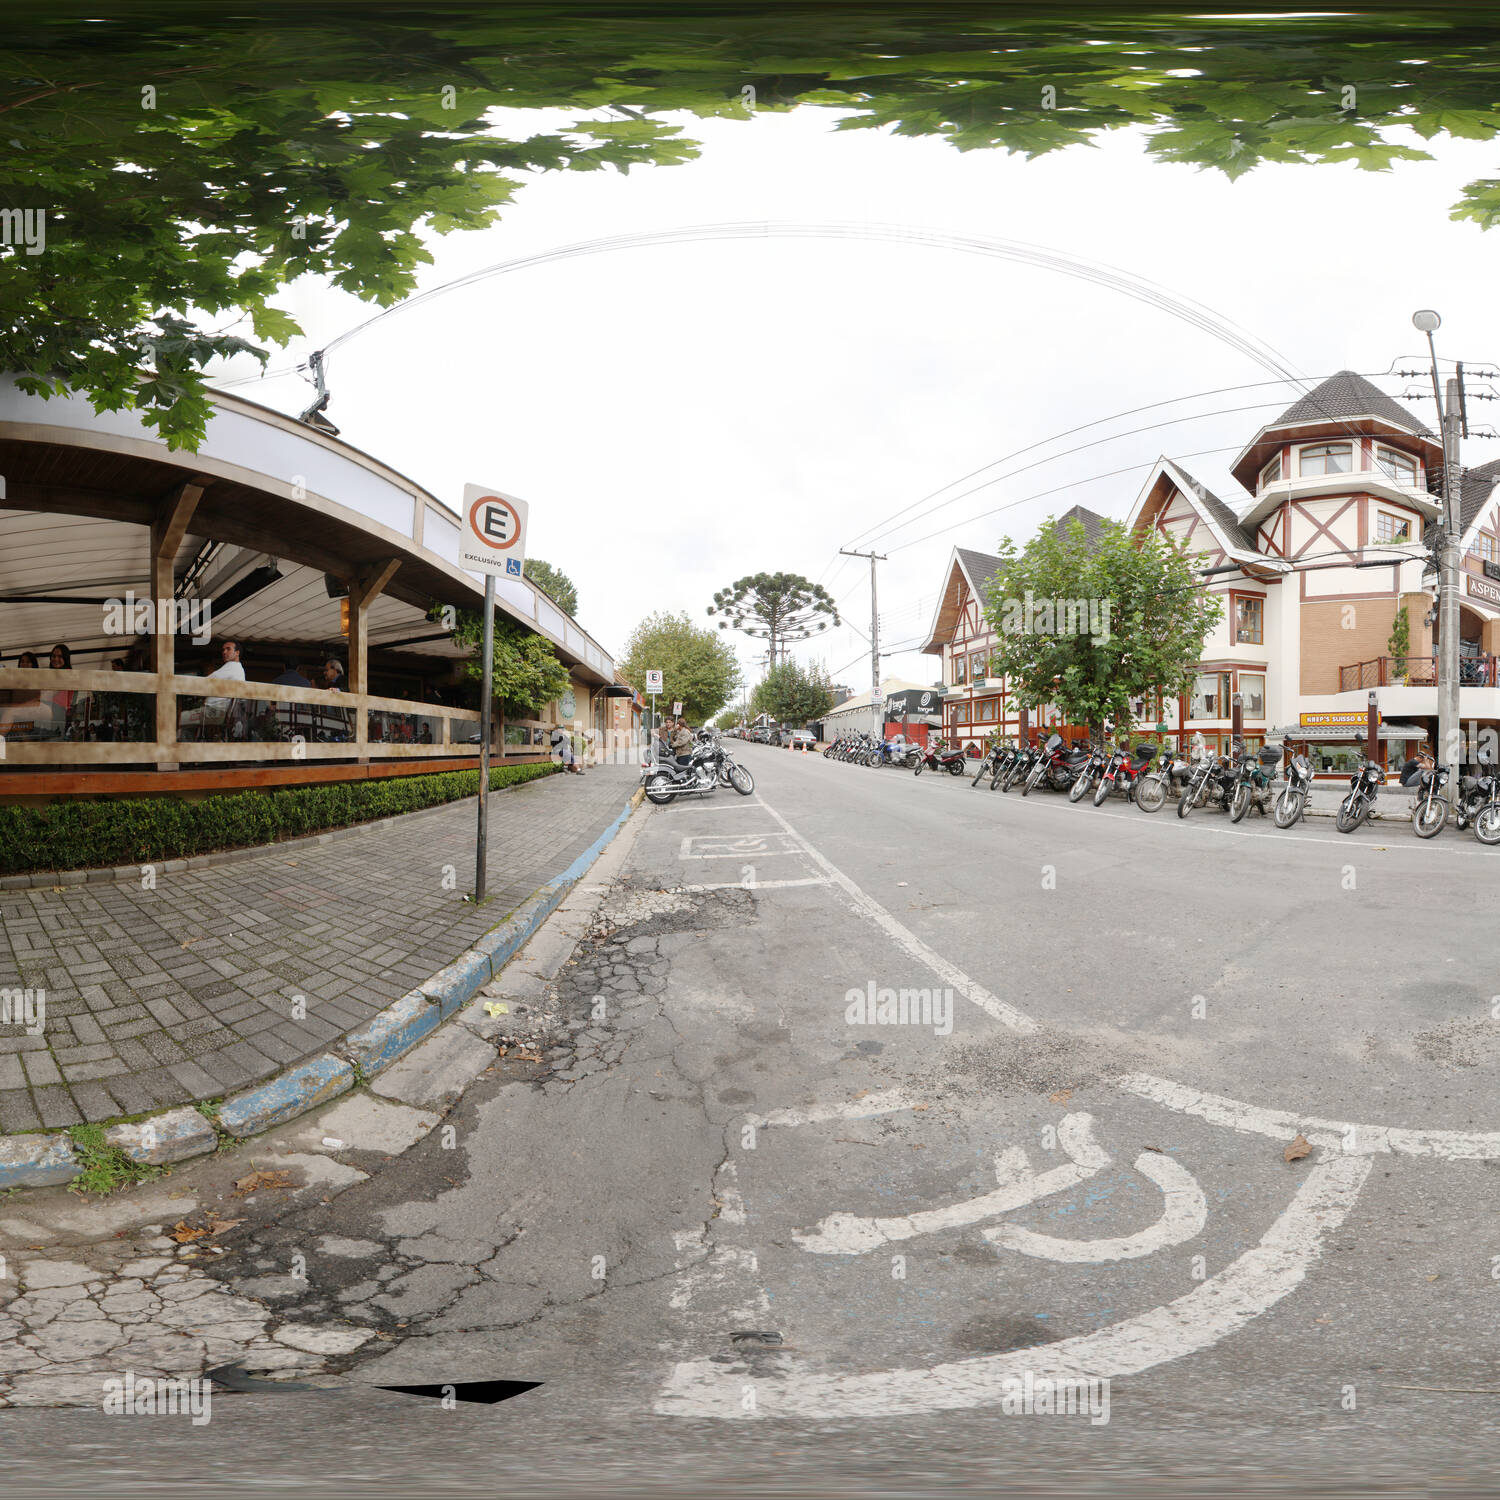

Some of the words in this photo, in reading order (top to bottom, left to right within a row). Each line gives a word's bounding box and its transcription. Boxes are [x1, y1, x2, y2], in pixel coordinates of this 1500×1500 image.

[484, 505, 508, 539] E
[464, 553, 502, 566] EXCLUSIVO
[652, 673, 658, 681] E
[918, 706, 934, 714] target
